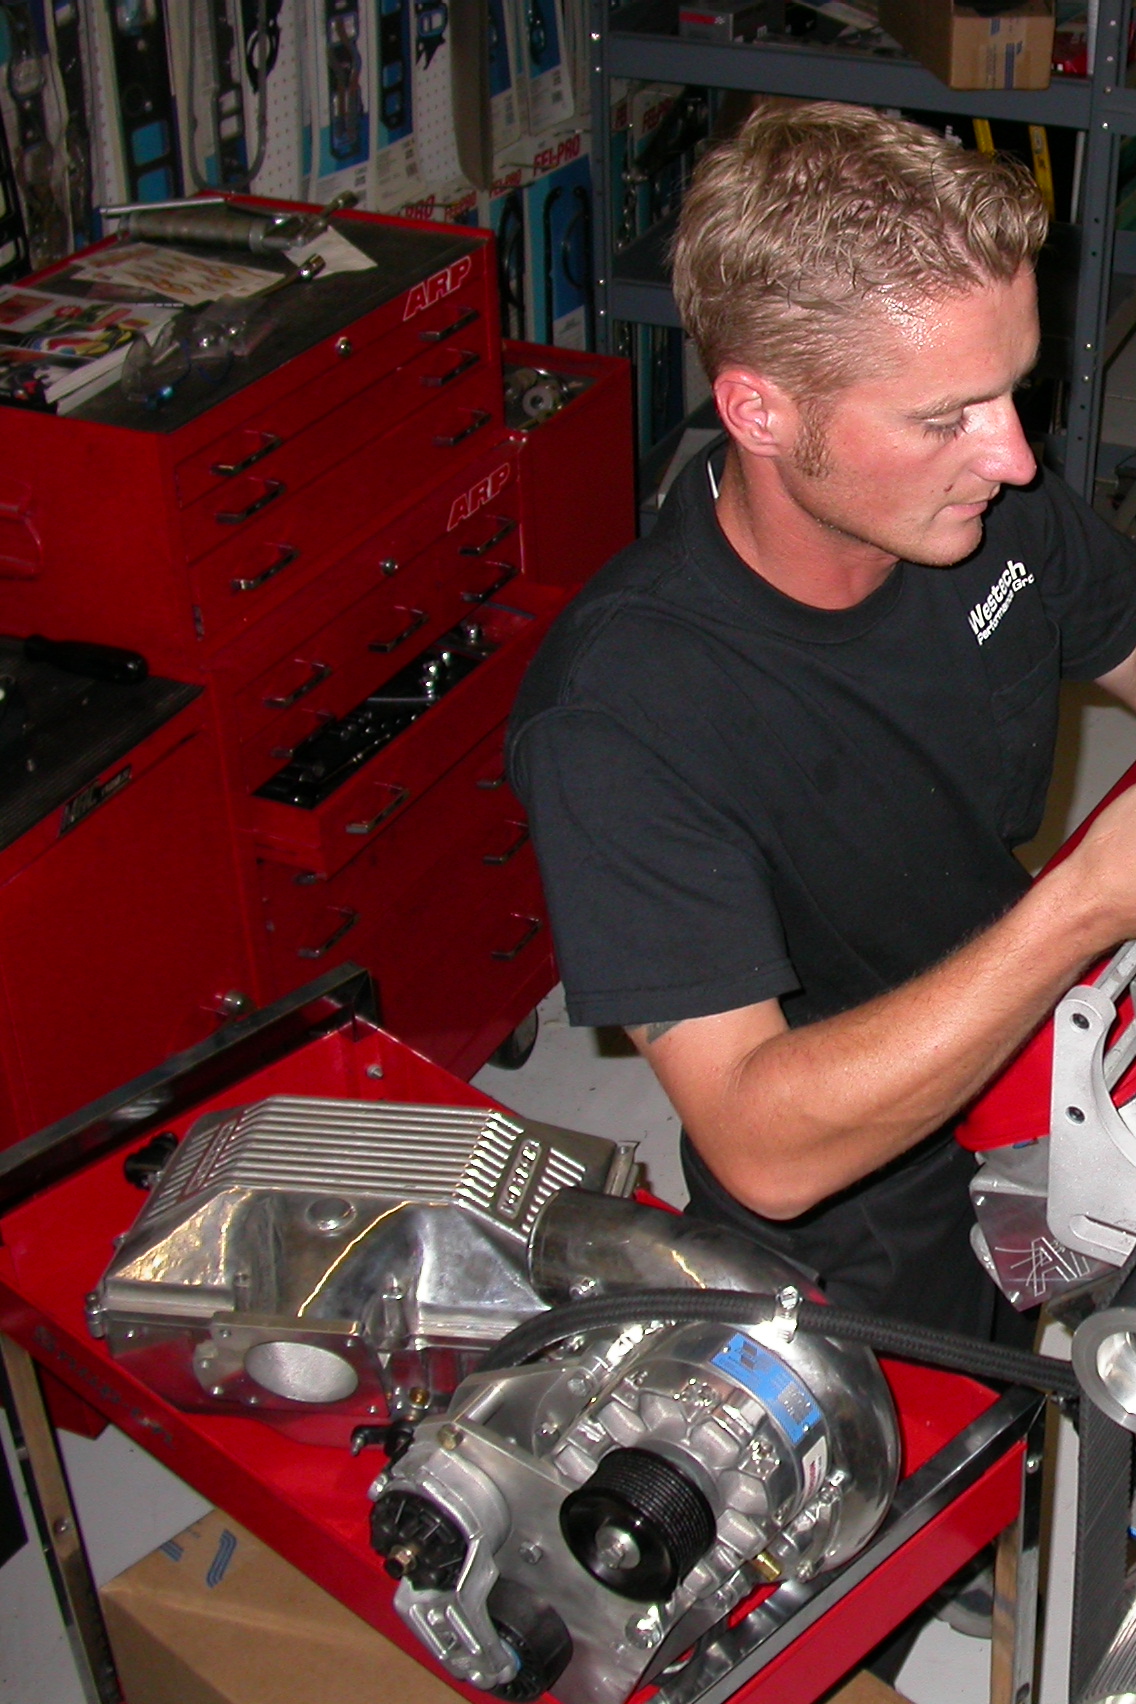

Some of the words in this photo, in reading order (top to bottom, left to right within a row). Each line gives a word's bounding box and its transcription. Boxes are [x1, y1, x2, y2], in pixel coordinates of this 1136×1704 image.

[403, 255, 472, 322] ARP
[446, 462, 511, 532] ARP
[967, 560, 1027, 635] Westech
